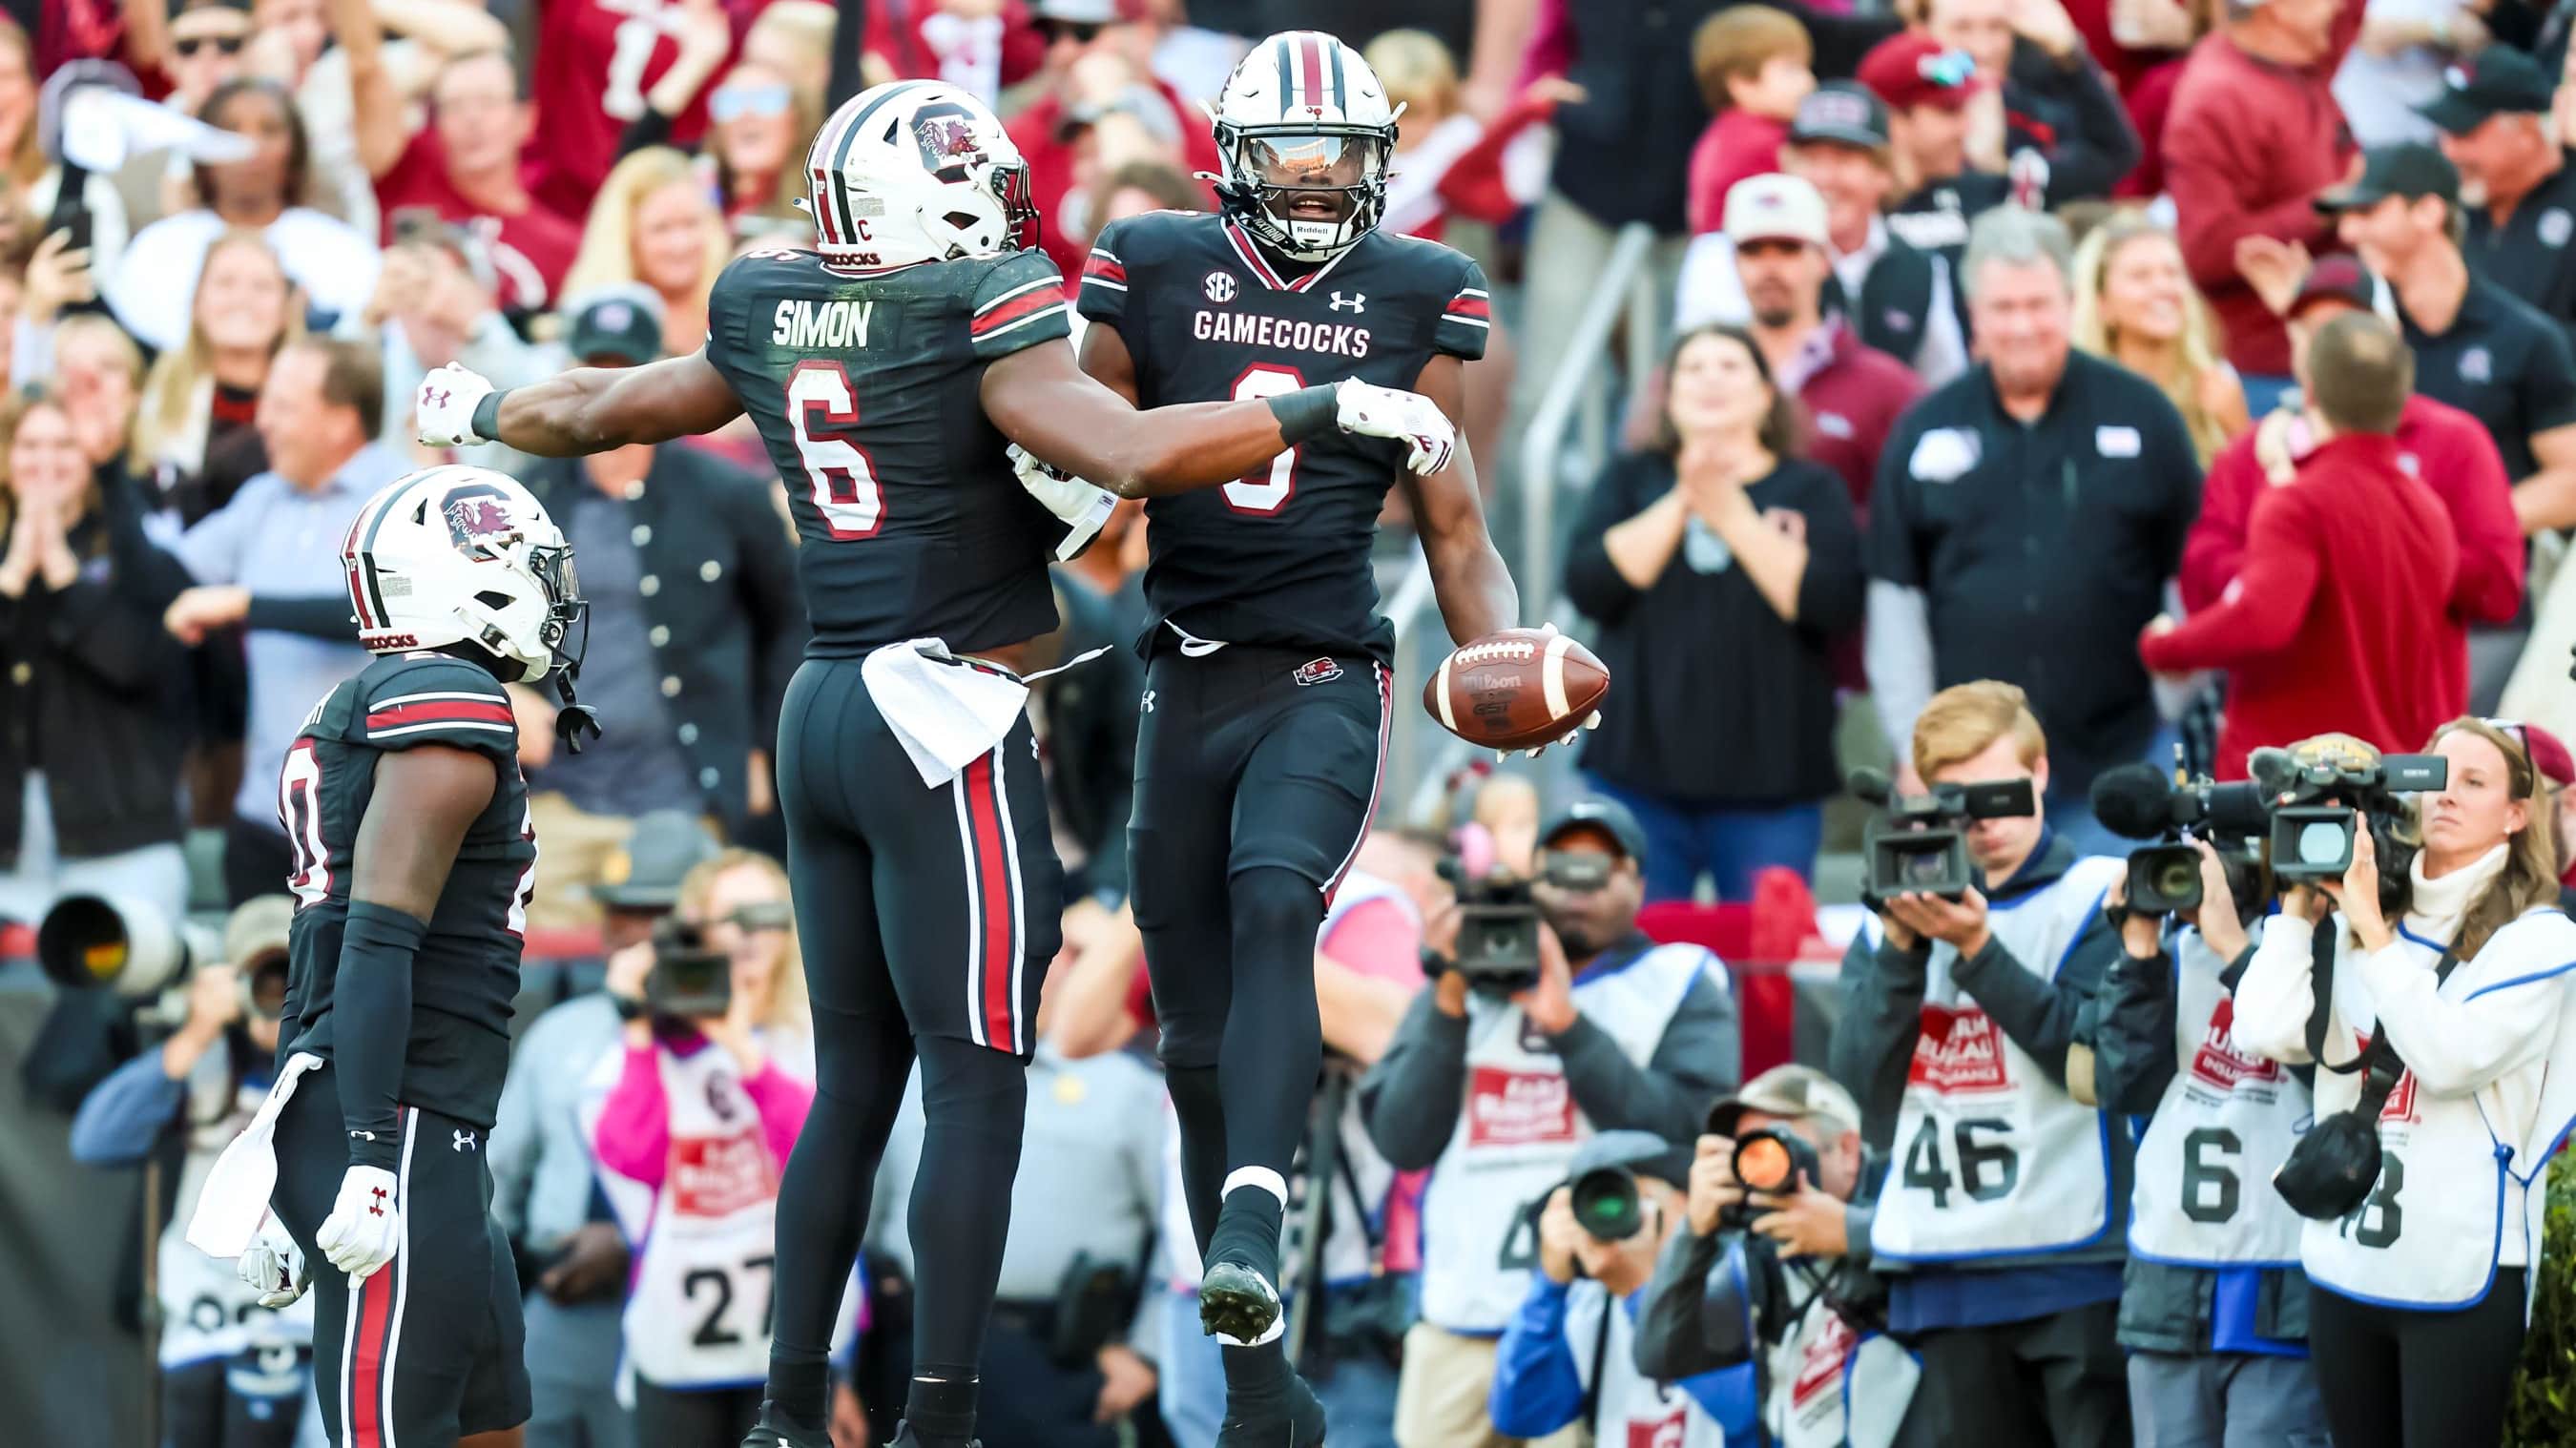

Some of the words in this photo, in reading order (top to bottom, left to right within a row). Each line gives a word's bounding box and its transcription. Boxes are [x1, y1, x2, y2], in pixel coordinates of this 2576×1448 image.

[857, 219, 872, 241] C
[1297, 225, 1329, 236] Riddell
[1204, 271, 1236, 303] SEC
[772, 299, 874, 348] SIMON
[1194, 309, 1371, 360] GAMECOCKS
[784, 359, 888, 539] 6
[1902, 1113, 2019, 1209] 46
[2181, 1127, 2242, 1224] 6
[683, 1251, 776, 1348] 27
